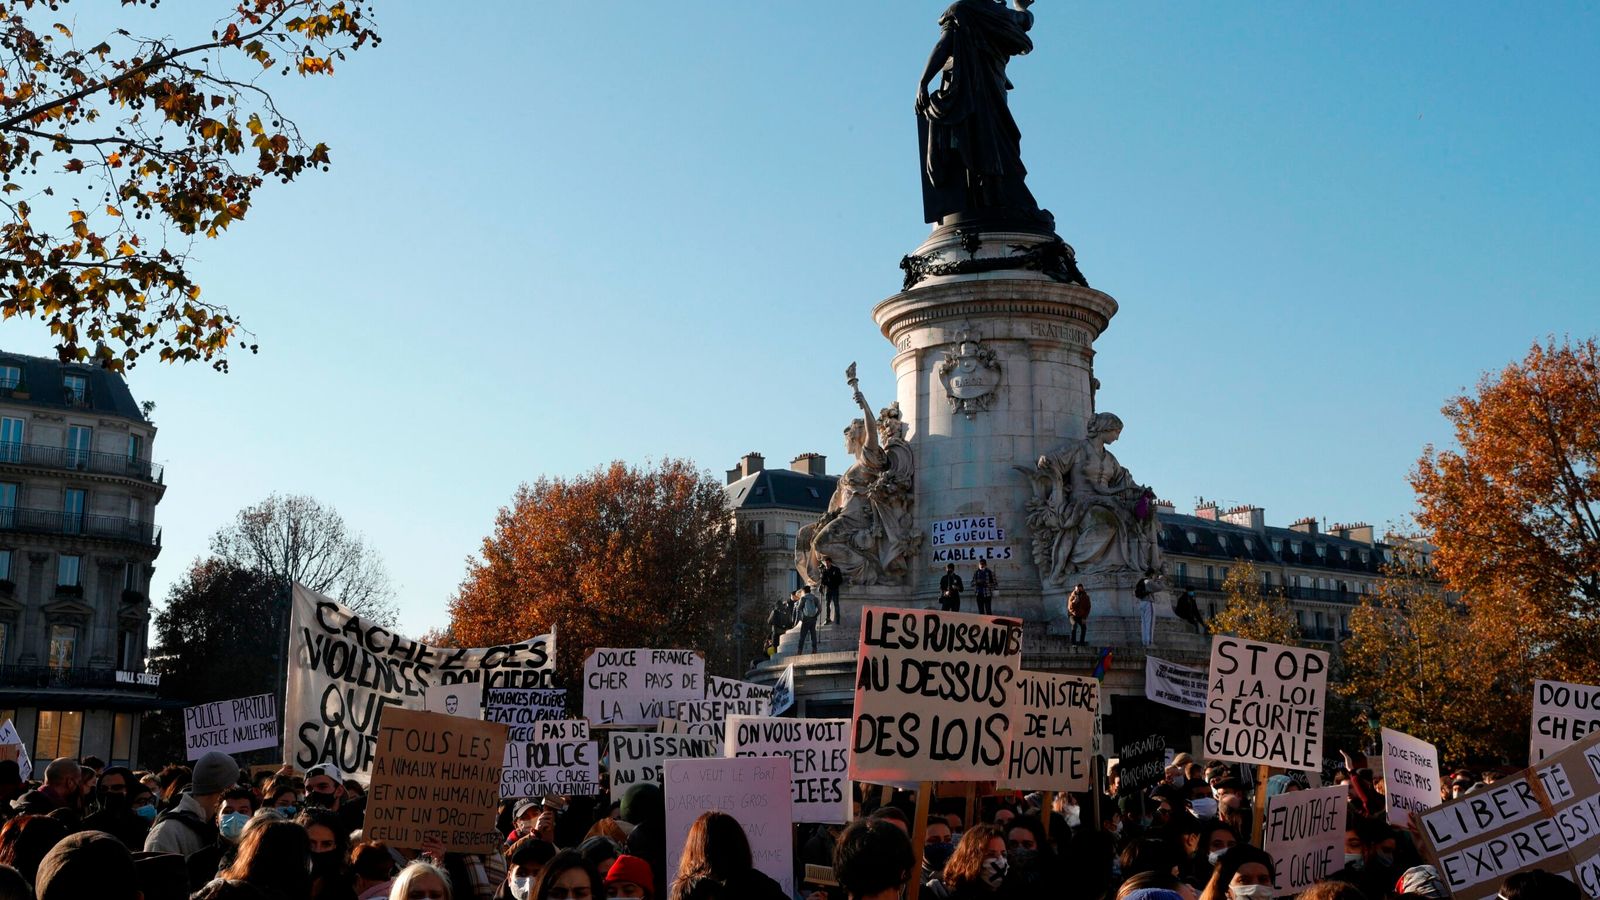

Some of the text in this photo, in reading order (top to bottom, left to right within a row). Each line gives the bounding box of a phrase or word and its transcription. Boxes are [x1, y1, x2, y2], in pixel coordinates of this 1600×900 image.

[933, 518, 995, 533] FLOUTAGE
[933, 530, 1003, 545] DE GUEULE
[864, 610, 1022, 656] LES PUISSANTS
[304, 627, 432, 696] VIOLENCES
[480, 641, 548, 669] CES
[597, 650, 695, 668] DOUCE FRANCE
[1217, 641, 1324, 682] STOP
[115, 670, 161, 686] WALL STREET
[588, 672, 699, 690] CHER PAYS DE
[711, 678, 742, 699] VOS
[857, 655, 1014, 708] AU DESSUS
[489, 689, 528, 707] VIOLENCES
[1212, 675, 1225, 694] À
[1279, 685, 1315, 705] LOI
[185, 694, 274, 730] POLICE PARTOUT
[601, 700, 623, 721] LA
[542, 722, 587, 740] PAS DE
[738, 721, 846, 747] ON VOUS VOIT
[1024, 713, 1072, 738] DE LA
[188, 728, 229, 749] JUSTICE
[382, 727, 491, 760] TOUS LES
[613, 734, 718, 763] PUISSANTS
[853, 712, 1010, 766] DES LOIS
[1205, 728, 1316, 767] GLOBALE
[526, 742, 589, 768] POLICE
[822, 748, 847, 773] LES
[1008, 740, 1084, 780] HONTE
[1388, 743, 1408, 760] DOUCE
[441, 762, 502, 785] HUMAINS
[502, 769, 590, 783] GRANDE CAUSE
[614, 768, 635, 786] AU
[700, 768, 724, 783] VEUT
[732, 769, 744, 782] LE
[1394, 768, 1432, 791] CHER PAYS
[374, 783, 497, 809] ET NON HUMAINS
[501, 782, 600, 797] DU QUINQUENNAT
[741, 794, 768, 809] GROS
[1427, 765, 1571, 844] LIBERTÉ
[374, 807, 485, 830] ONT UN DROIT
[1271, 796, 1341, 842] FLOUTAGE
[369, 826, 408, 842] CELUI
